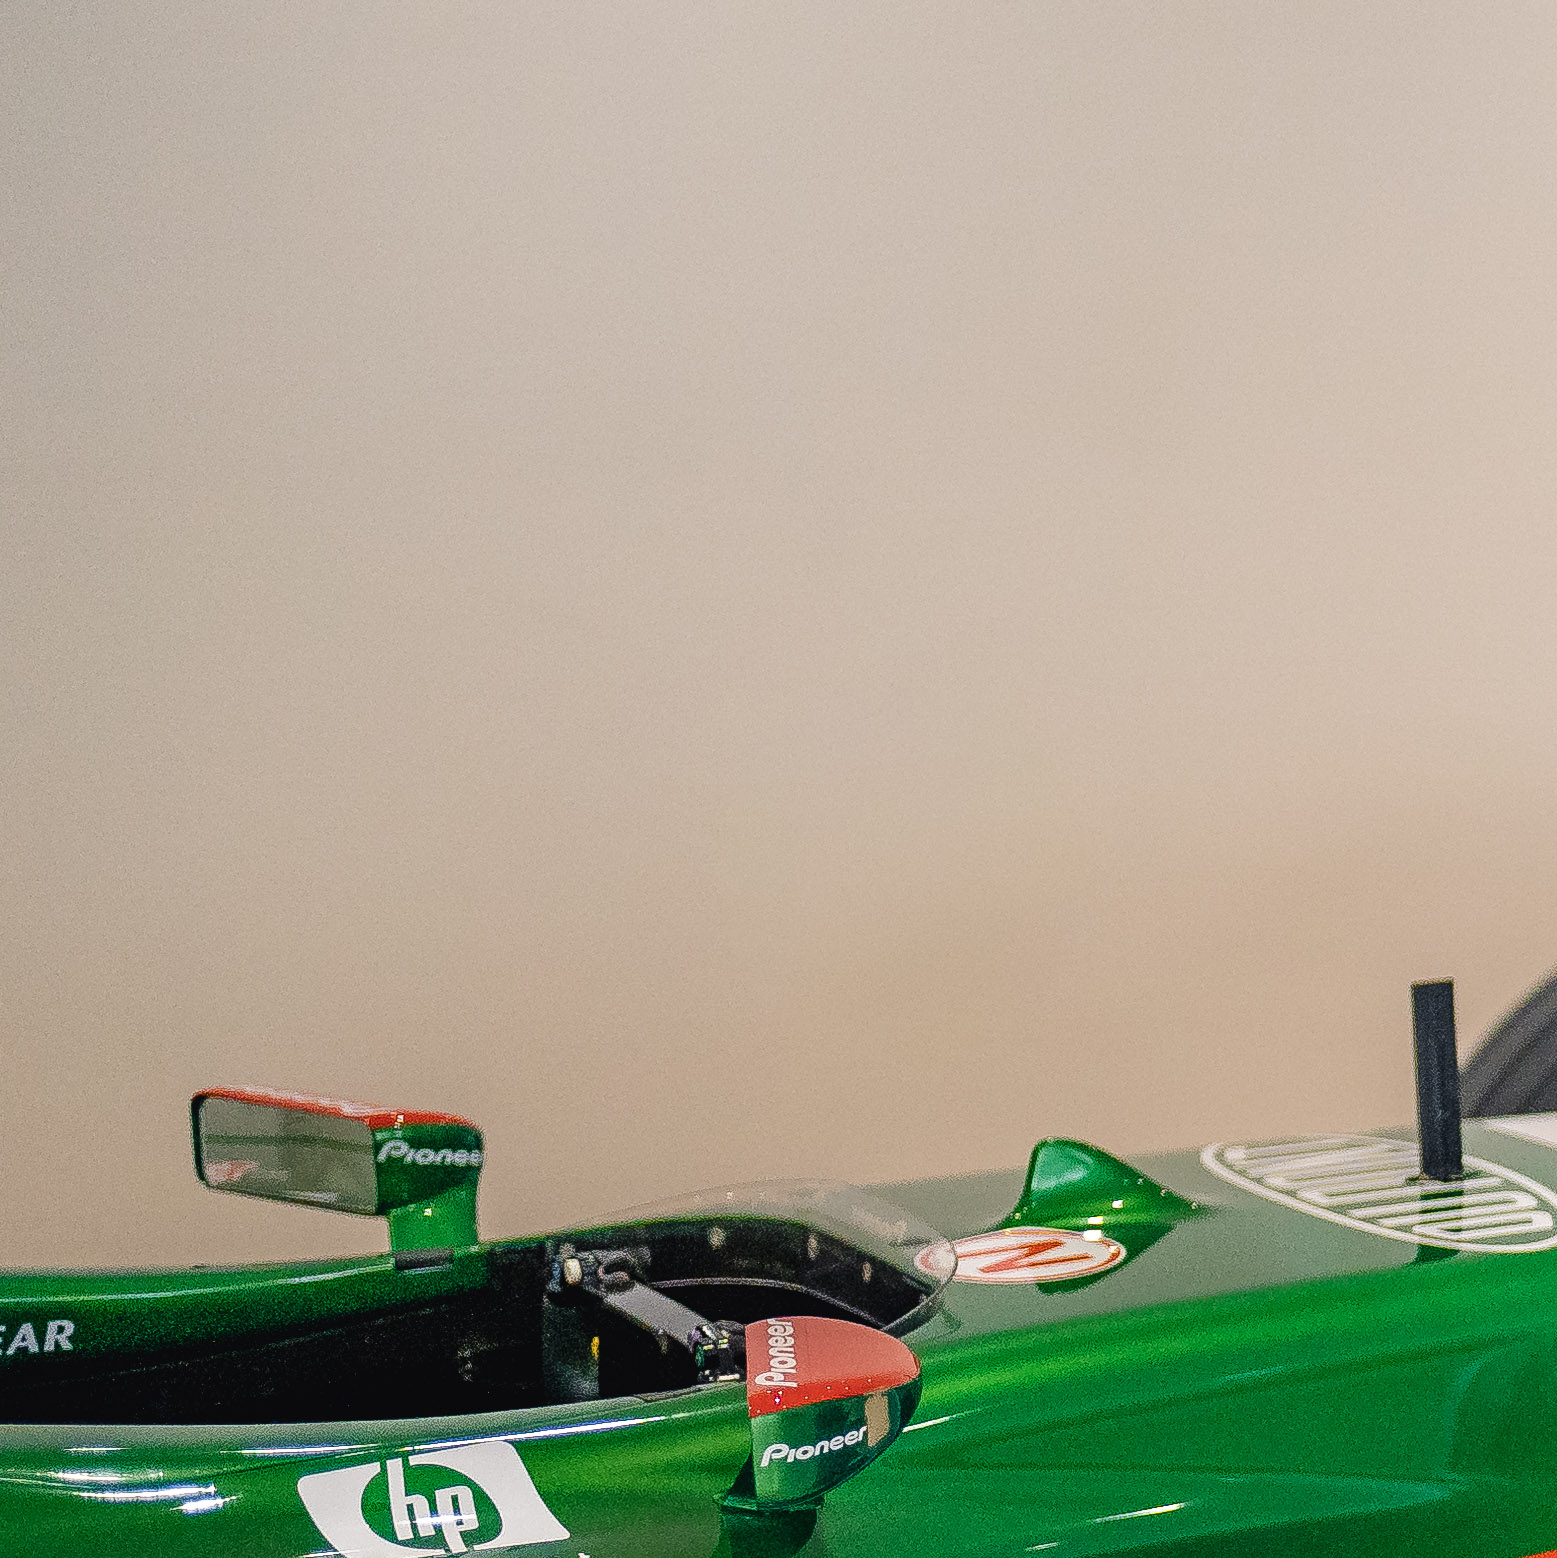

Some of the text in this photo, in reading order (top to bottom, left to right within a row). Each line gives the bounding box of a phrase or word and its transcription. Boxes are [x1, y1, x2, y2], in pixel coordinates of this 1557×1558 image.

[377, 1139, 482, 1166] Pionee
[0, 1319, 75, 1356] AR
[754, 1318, 798, 1388] Pioneer
[759, 1425, 868, 1468] Pioneer
[386, 1457, 480, 1554] hp
